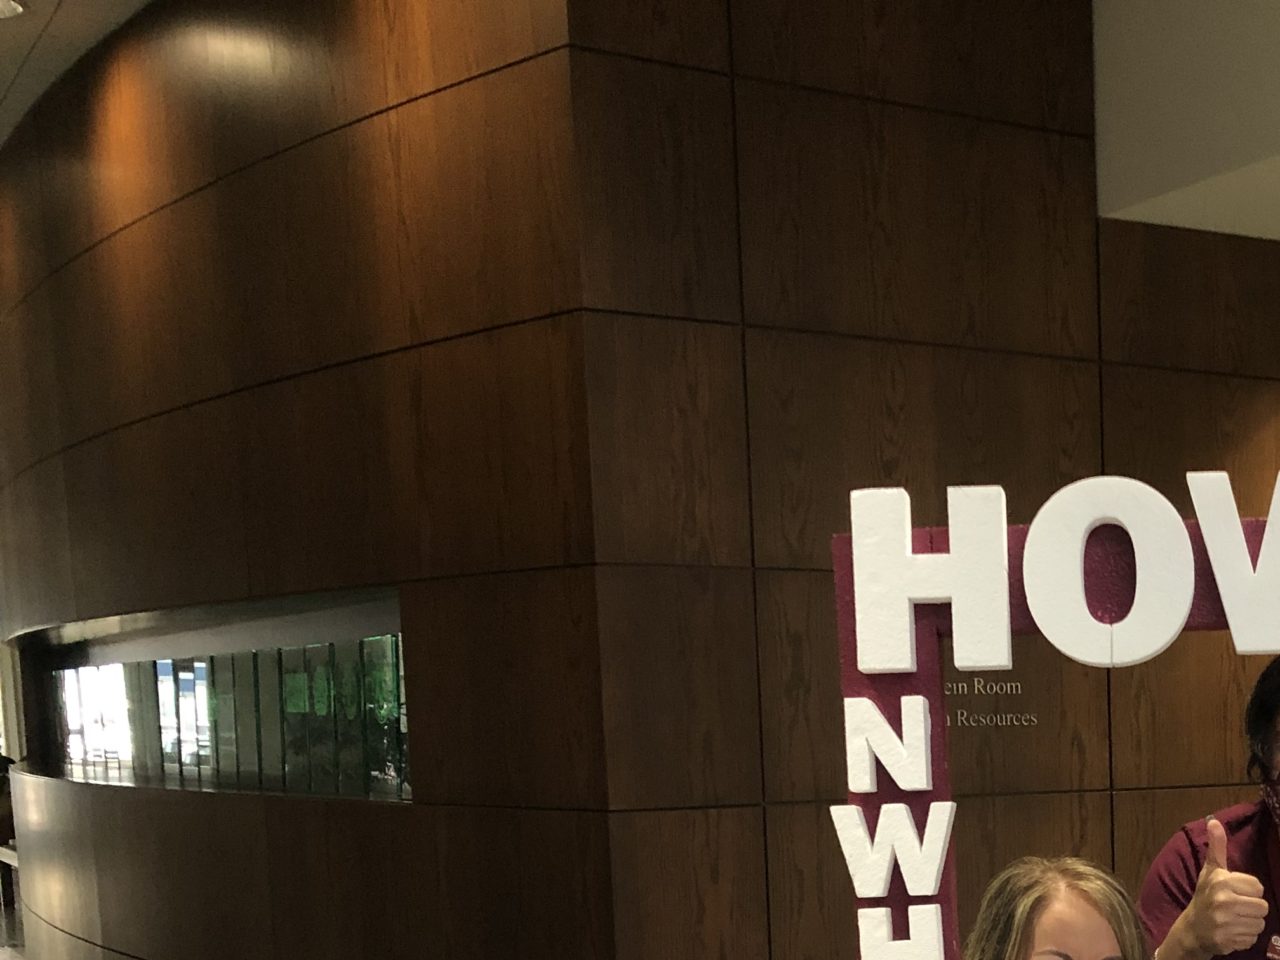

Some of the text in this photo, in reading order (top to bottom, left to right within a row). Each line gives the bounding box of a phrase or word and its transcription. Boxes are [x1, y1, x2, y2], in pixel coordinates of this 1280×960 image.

[944, 677, 1021, 695] ein Room
[957, 709, 1038, 727] Resources
